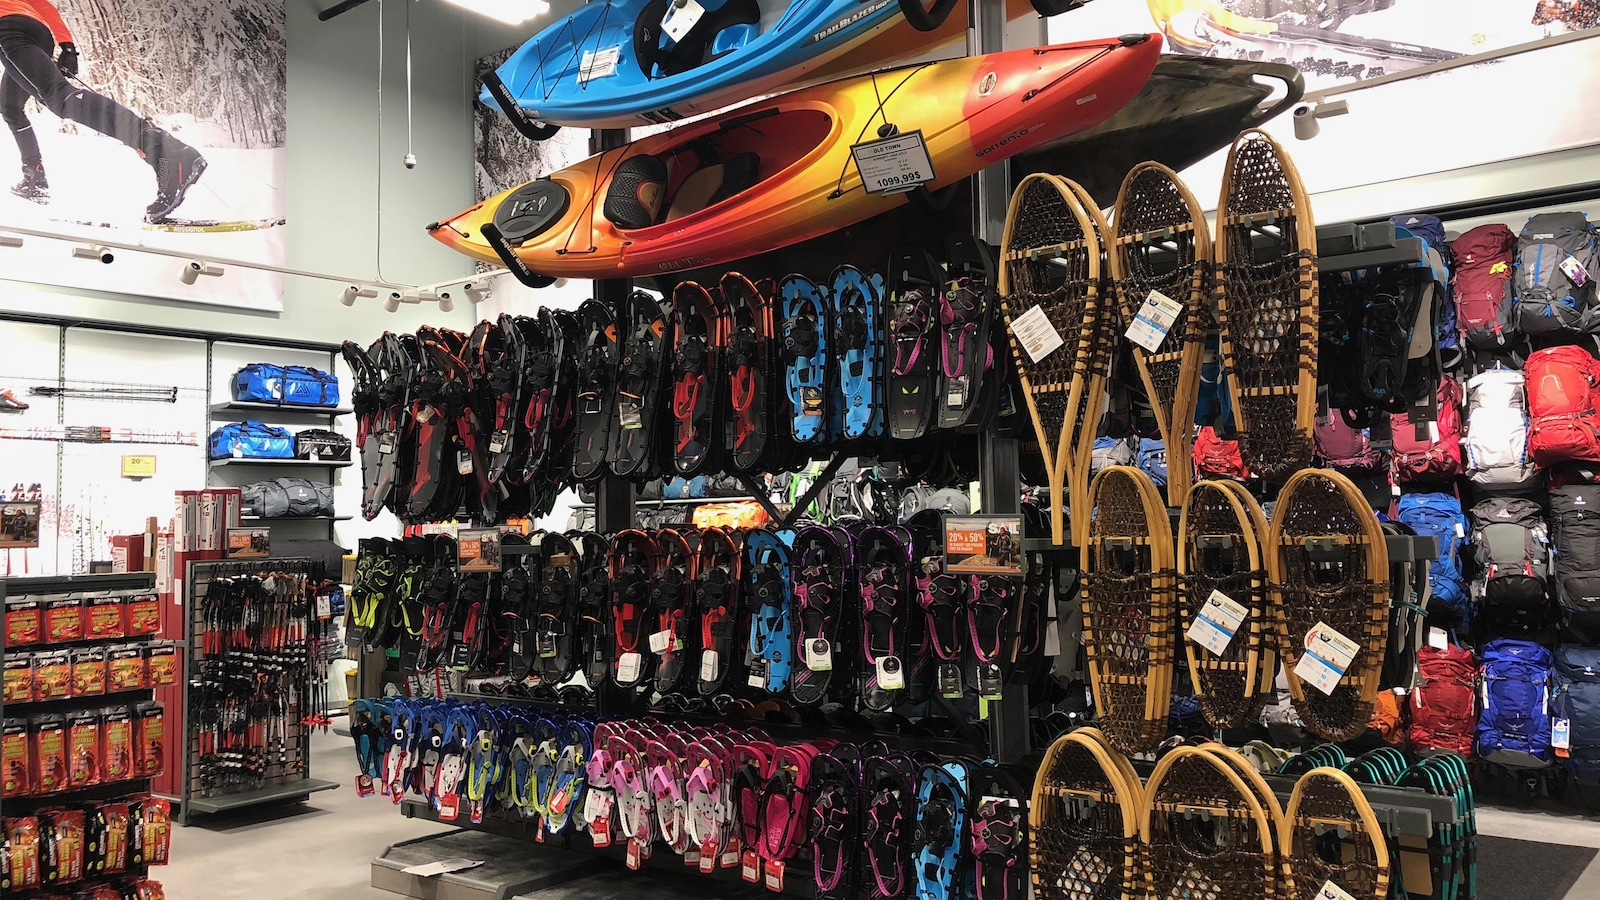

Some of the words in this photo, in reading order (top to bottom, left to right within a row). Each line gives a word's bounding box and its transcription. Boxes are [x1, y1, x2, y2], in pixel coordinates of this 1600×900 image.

[814, 5, 875, 41] TRAILBLAZER
[976, 128, 1029, 157] sorrento
[877, 171, 921, 187] 1099,99$
[949, 533, 963, 542] 20%
[970, 533, 984, 542] 50%
